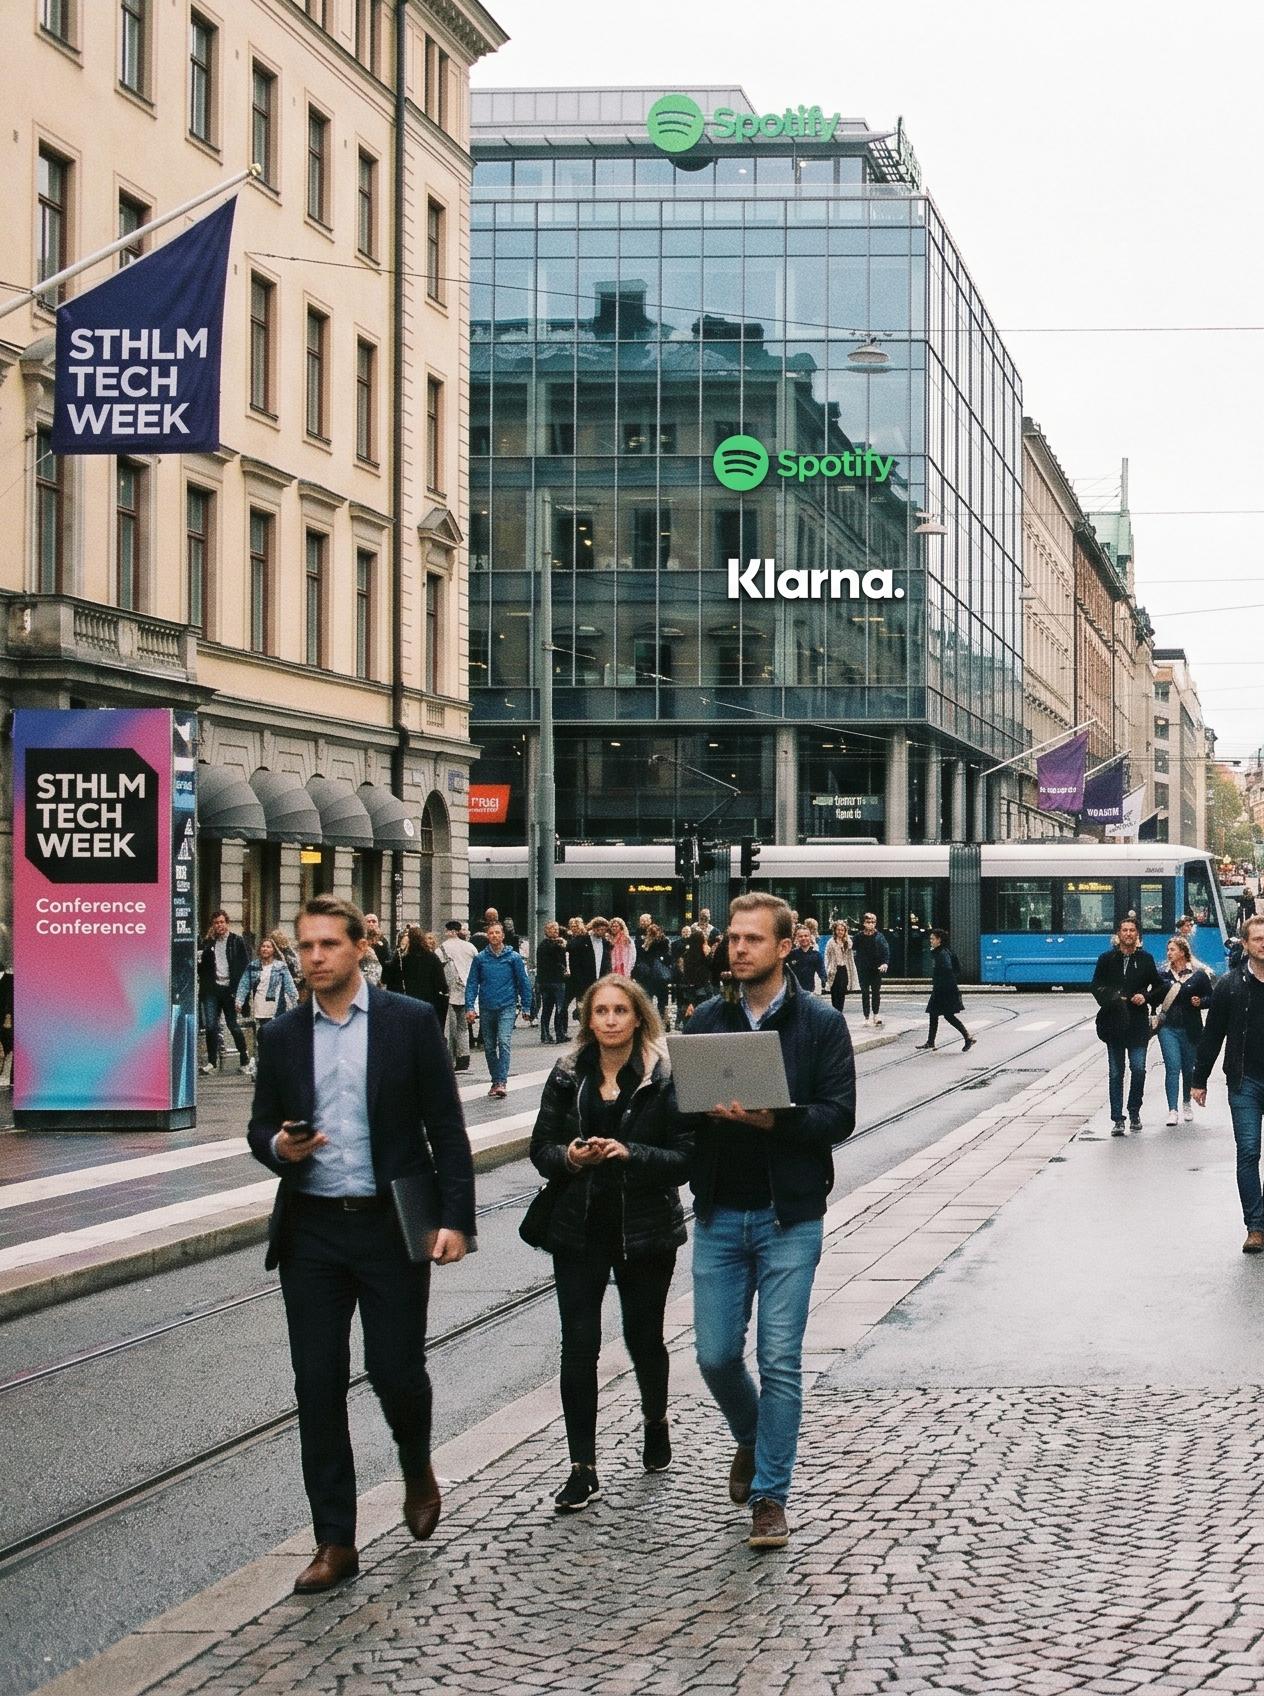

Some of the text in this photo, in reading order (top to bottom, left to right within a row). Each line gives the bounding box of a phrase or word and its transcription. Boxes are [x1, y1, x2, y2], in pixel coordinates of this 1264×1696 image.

[713, 104, 840, 143] Spotify
[69, 327, 208, 361] STHLM
[68, 365, 178, 398] TECH
[66, 402, 191, 435] WEEK
[777, 447, 895, 482] Spotify
[727, 558, 905, 599] Klarna.
[36, 773, 146, 799] STHLM
[36, 802, 122, 829] TECH
[36, 832, 136, 858] WEEK
[35, 897, 147, 913] Conference
[35, 918, 147, 935] Conference
